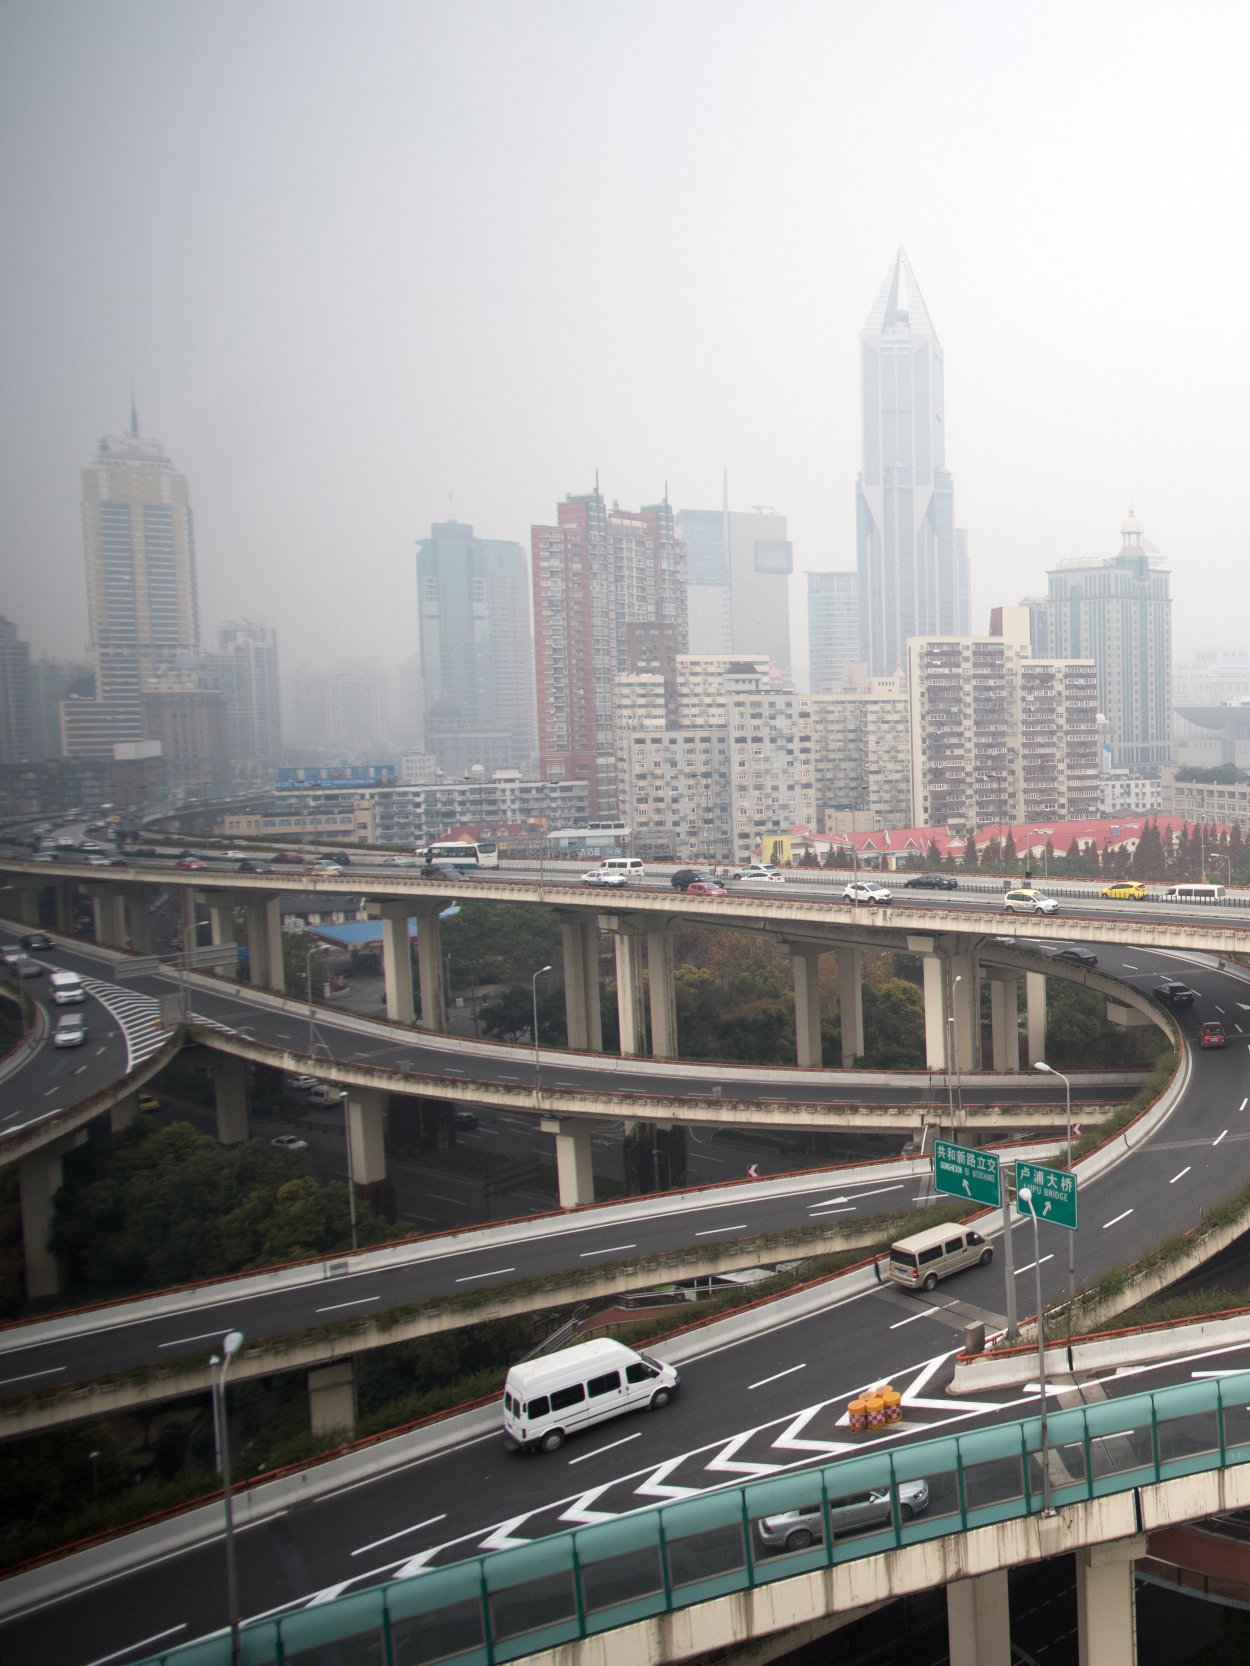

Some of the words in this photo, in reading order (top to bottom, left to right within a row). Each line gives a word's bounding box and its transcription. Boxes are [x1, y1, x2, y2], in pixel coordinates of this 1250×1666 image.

[937, 1145, 996, 1174] 共和新路立交
[1020, 1166, 1072, 1193] 卢浦大桥
[1043, 1188, 1069, 1202] BRIDGE
